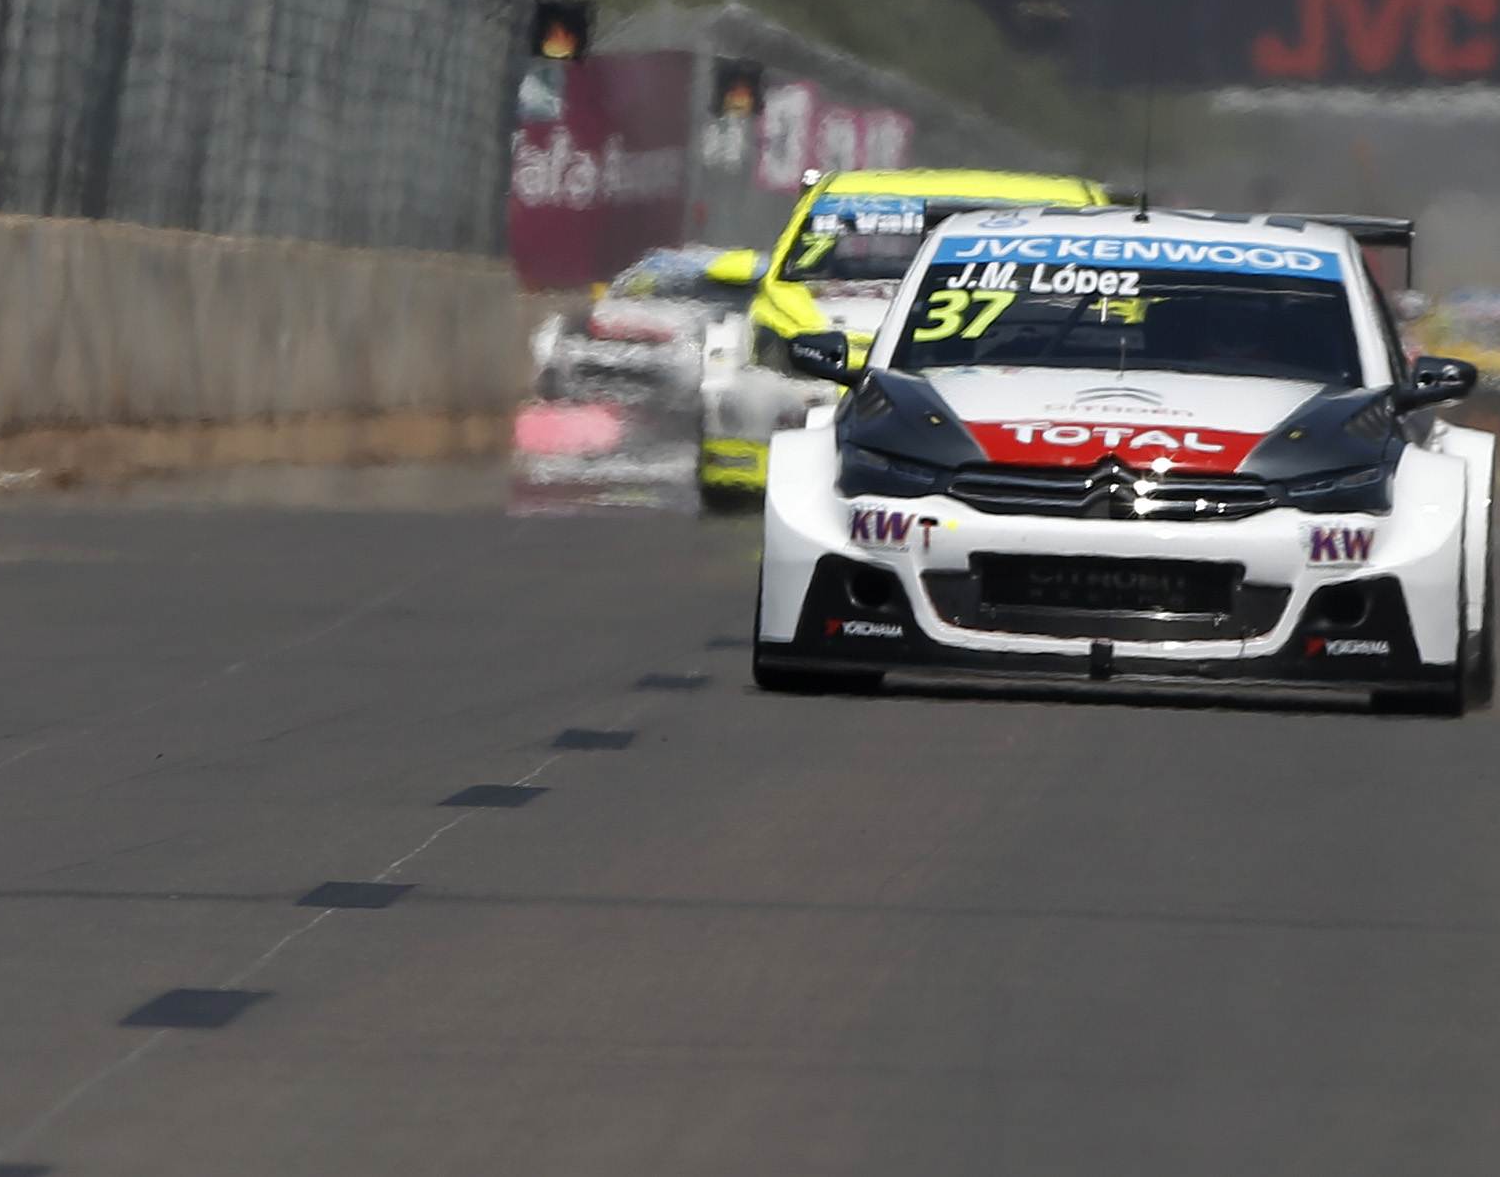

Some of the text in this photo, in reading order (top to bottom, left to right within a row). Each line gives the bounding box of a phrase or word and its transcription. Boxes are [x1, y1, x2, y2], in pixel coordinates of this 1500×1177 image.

[796, 232, 836, 269] 7
[946, 261, 1140, 296] J.M. López
[913, 290, 1018, 343] 37
[851, 510, 917, 543] KW
[1311, 527, 1375, 561] KW
